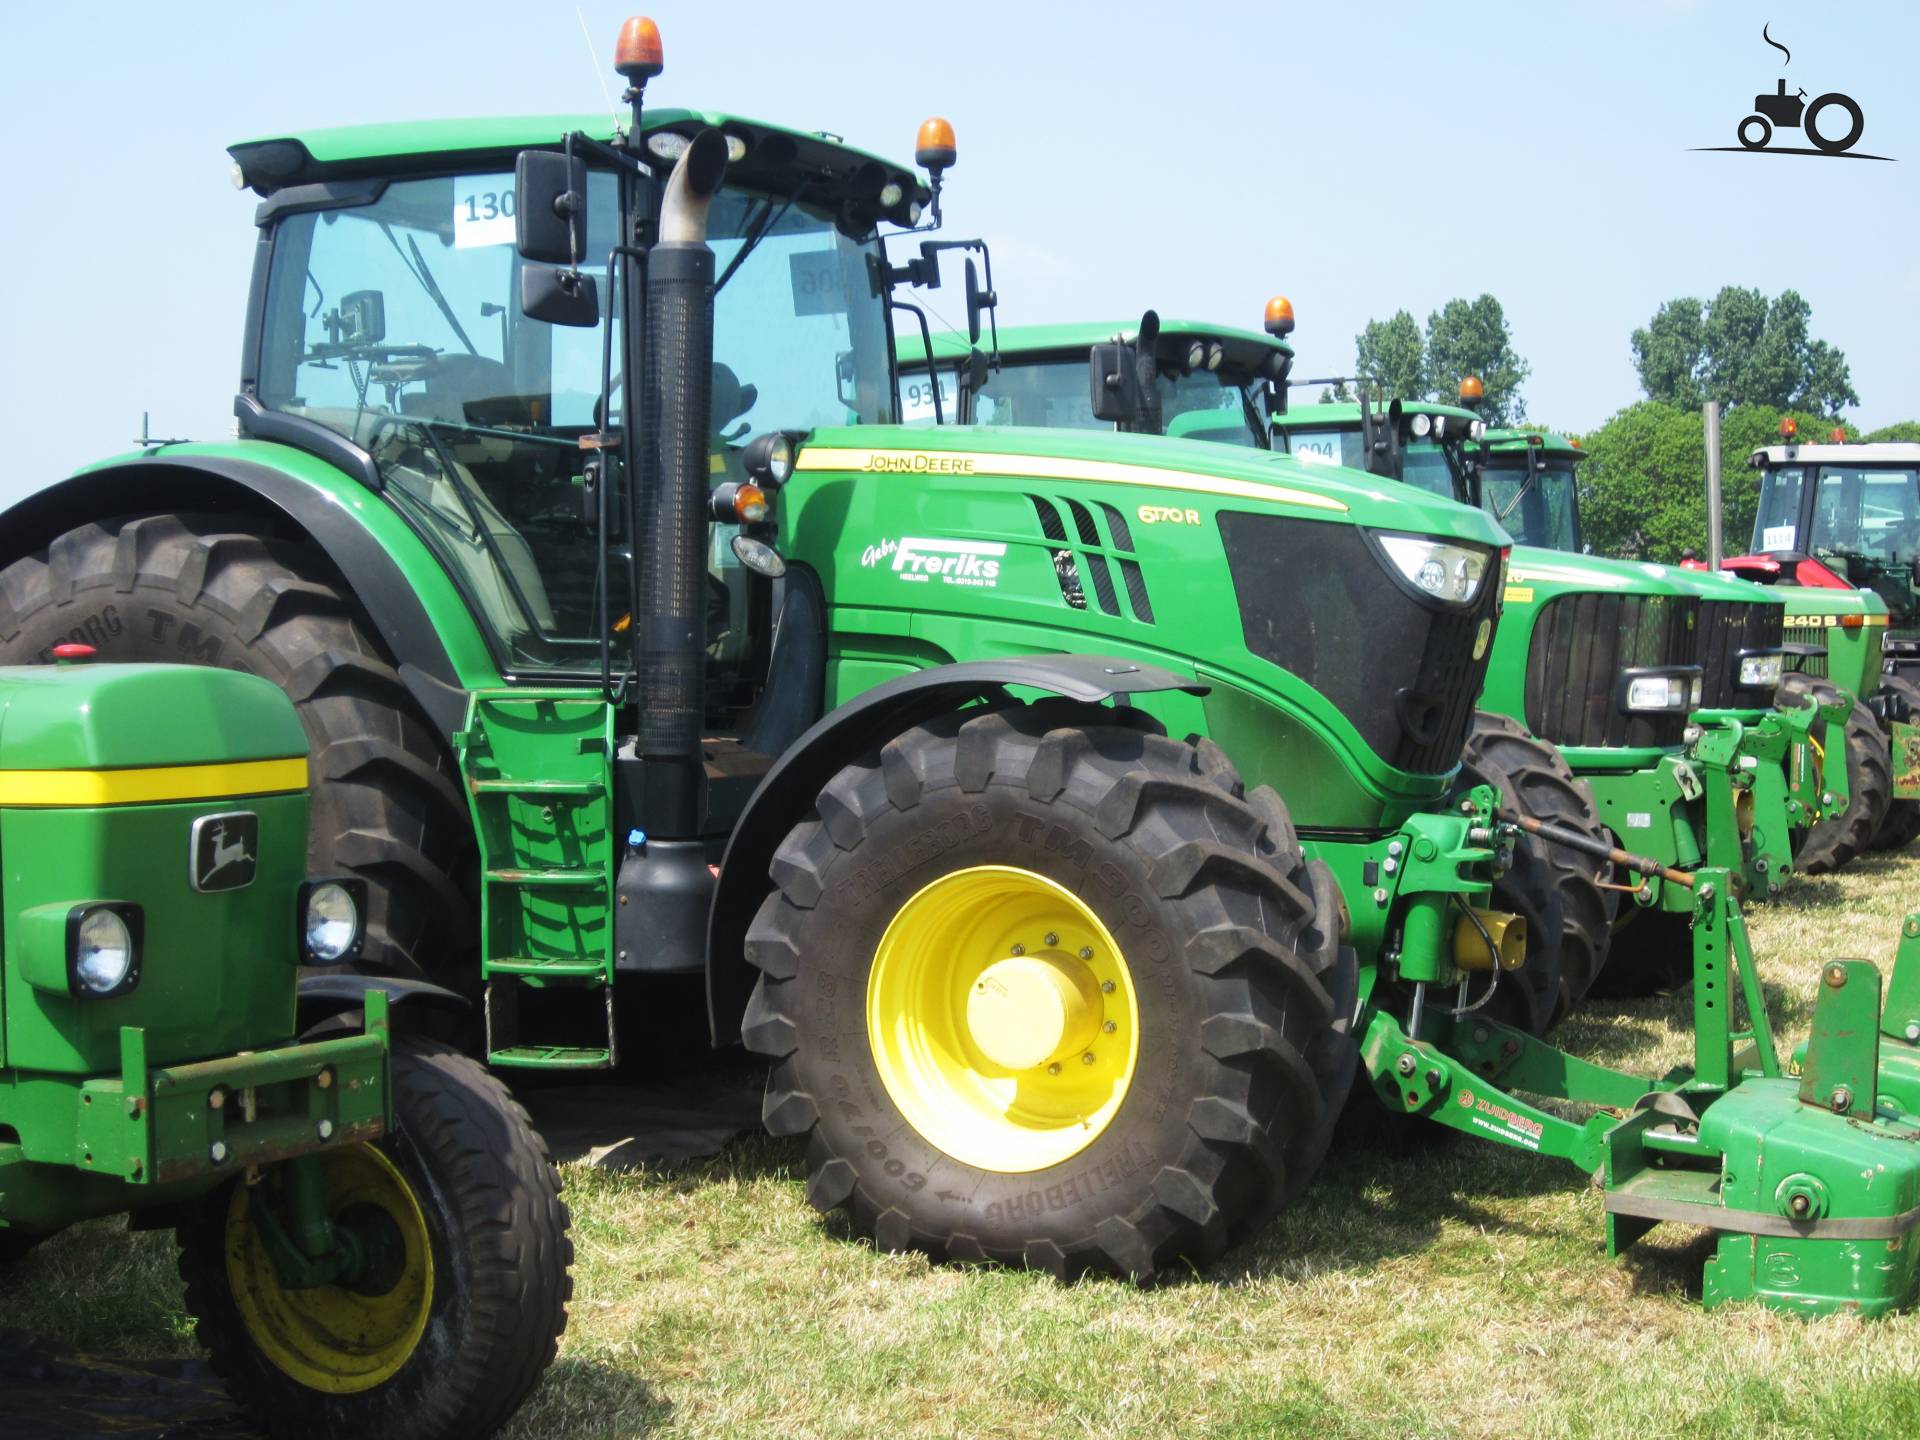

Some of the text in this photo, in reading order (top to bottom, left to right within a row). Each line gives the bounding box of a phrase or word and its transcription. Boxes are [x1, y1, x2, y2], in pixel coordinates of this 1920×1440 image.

[864, 454, 974, 471] JOHN DEERE
[891, 537, 1007, 577] Freriks
[835, 804, 994, 906] TRELLEBORG
[1476, 1098, 1544, 1136] ZUIDBERG
[983, 1141, 1157, 1222] TRELLEBORG
